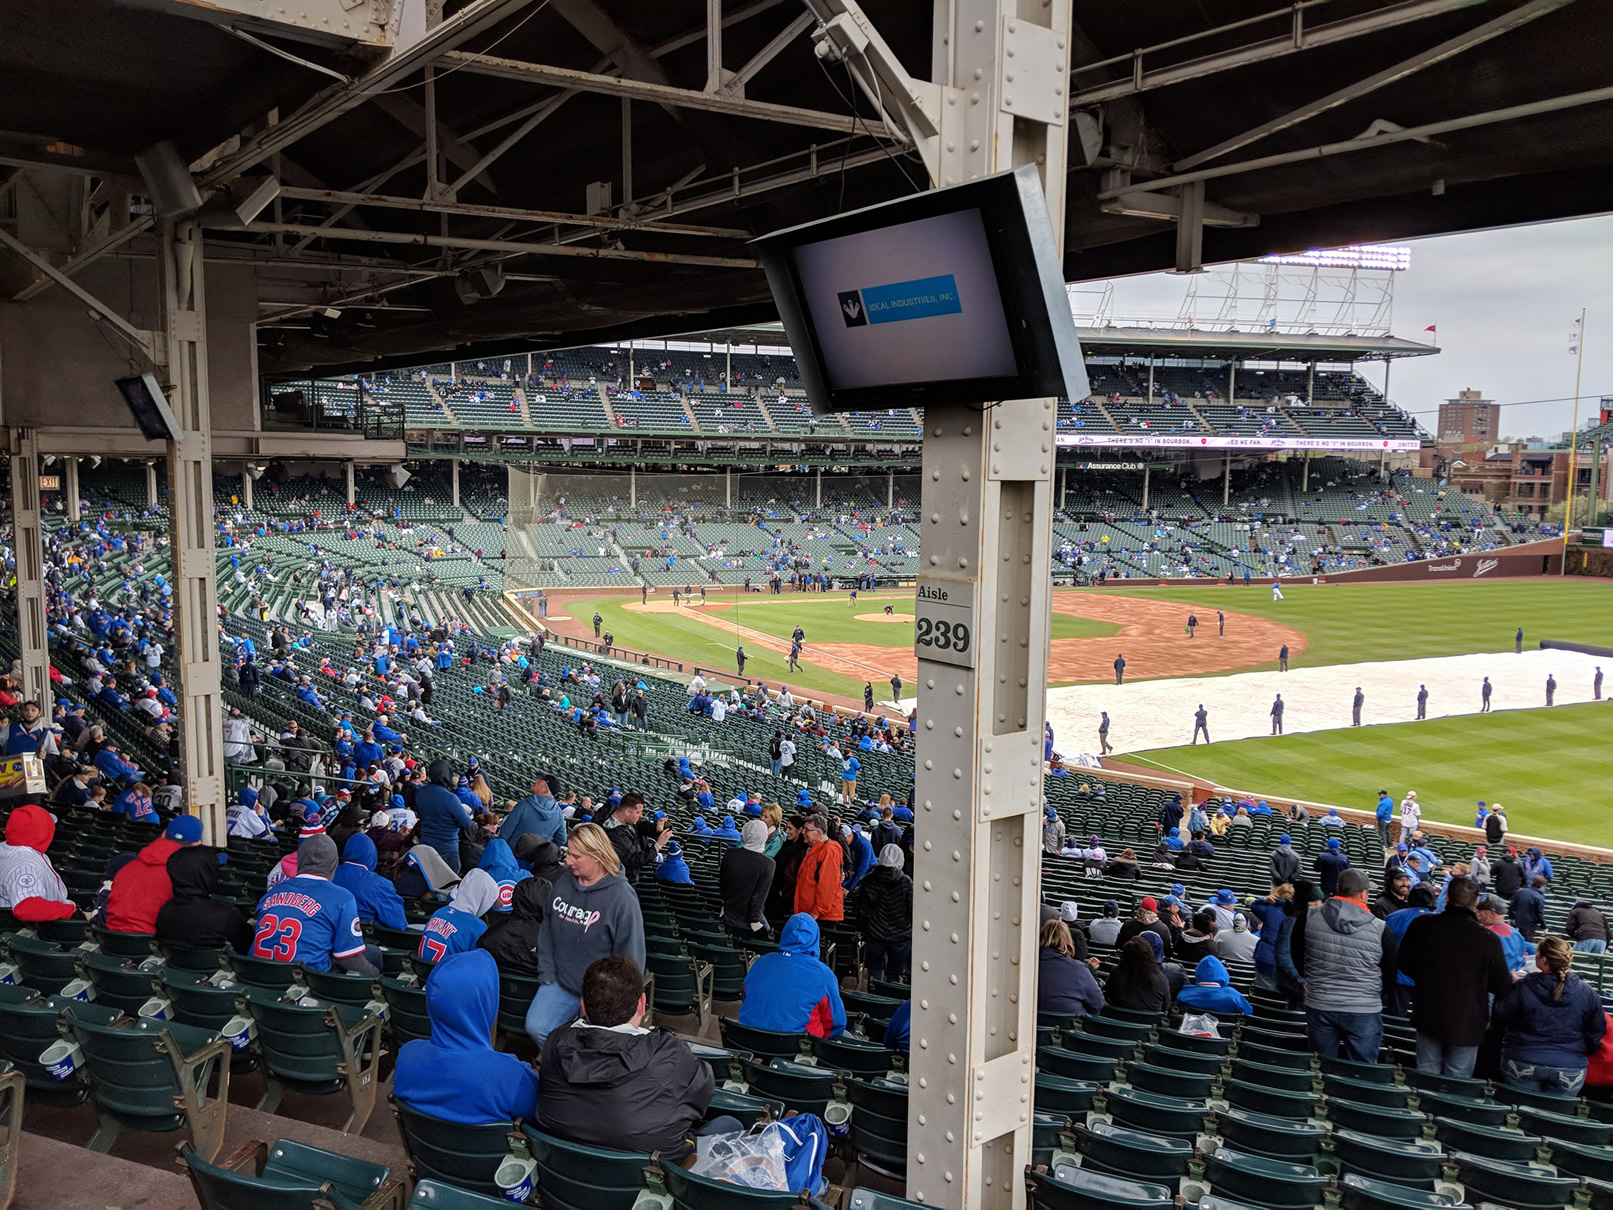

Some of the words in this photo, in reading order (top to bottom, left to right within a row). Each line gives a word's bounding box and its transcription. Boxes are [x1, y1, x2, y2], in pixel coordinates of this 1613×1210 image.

[868, 299, 890, 312] IDEAL
[938, 292, 956, 302] INC.
[1087, 462, 1121, 470] Assurance
[1121, 462, 1136, 470] Club
[41, 477, 57, 487] EXIT
[1428, 564, 1457, 572] TransUnion
[917, 585, 949, 601] Aisle
[916, 617, 970, 653] 239
[134, 796, 154, 817] 12
[1402, 806, 1412, 816] 17
[262, 890, 322, 918] SANDBERG
[253, 913, 303, 962] 23
[418, 935, 447, 963] 17
